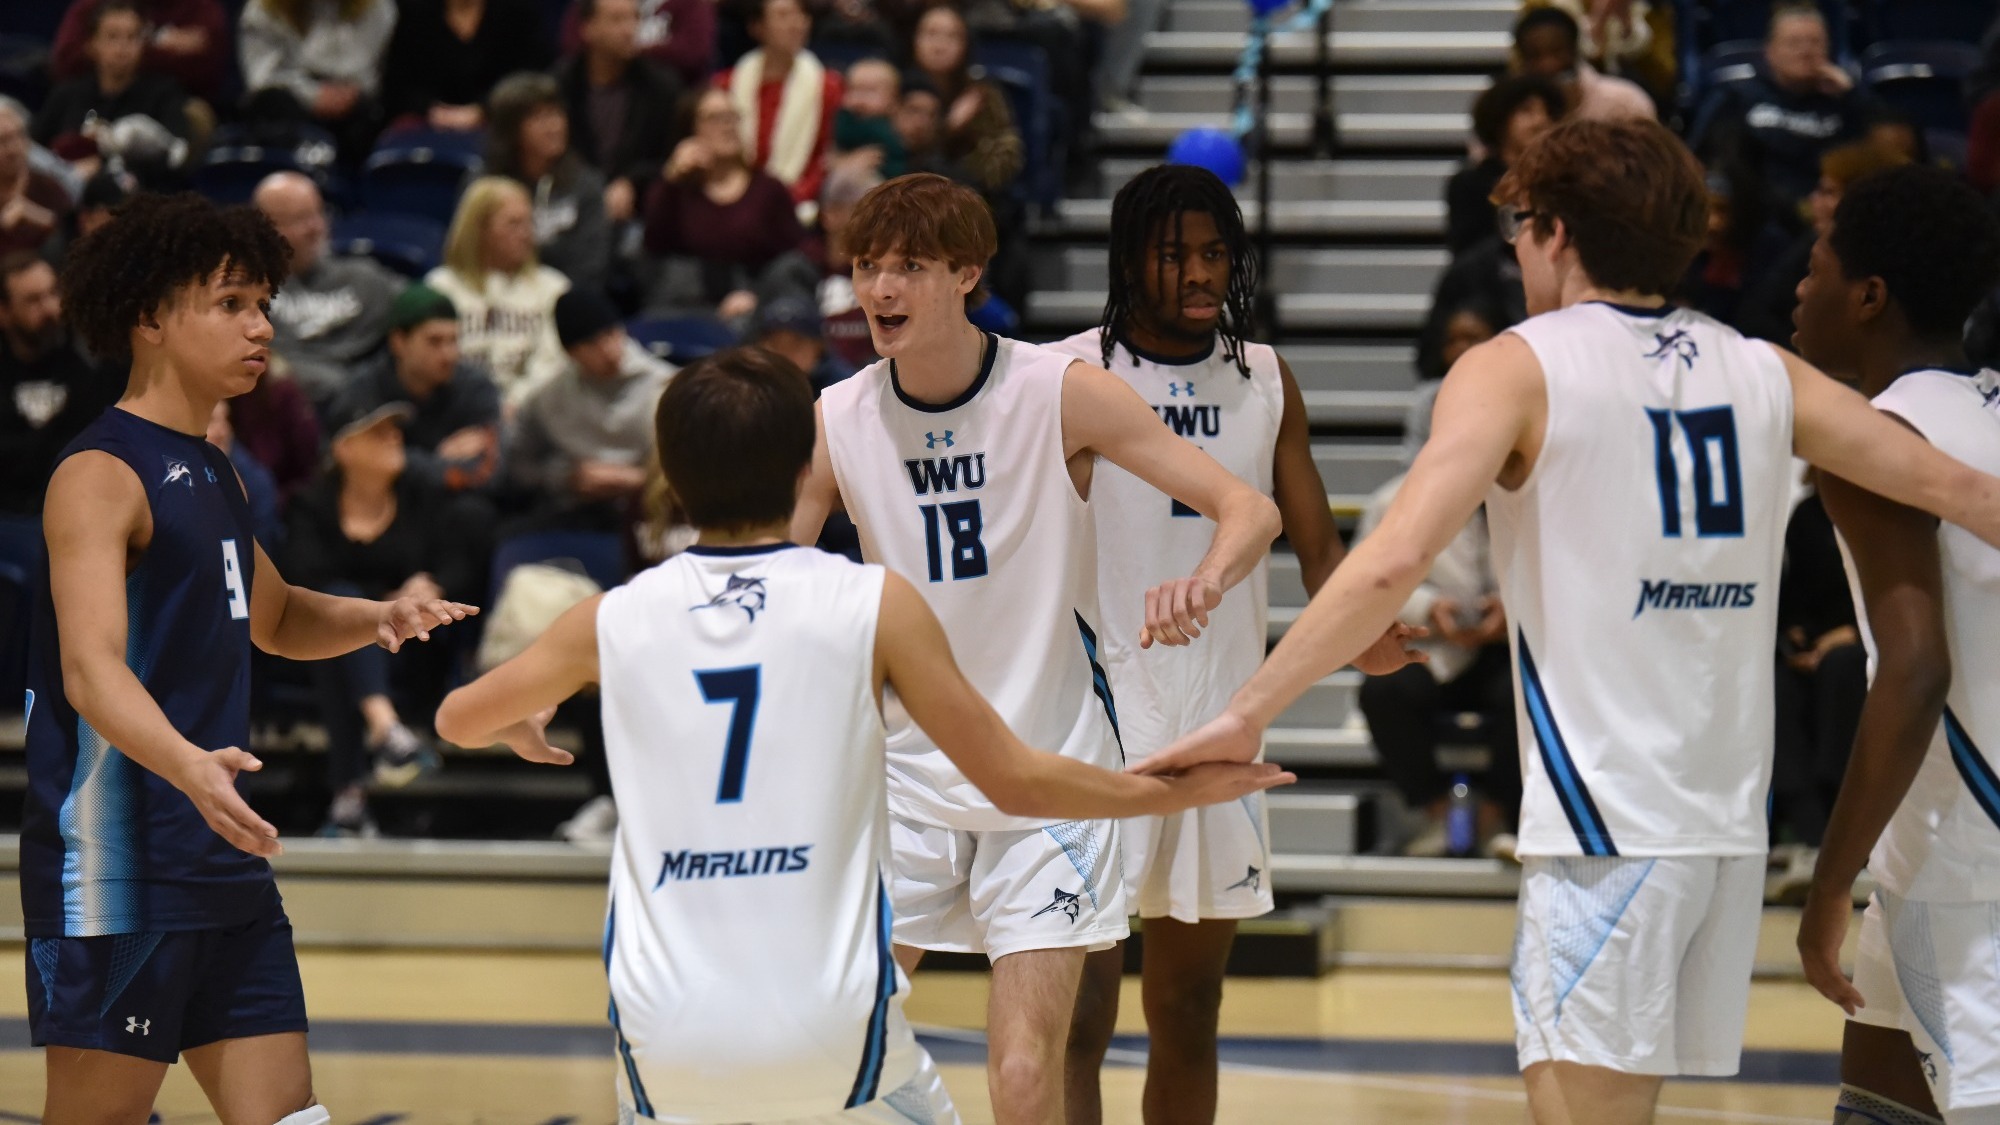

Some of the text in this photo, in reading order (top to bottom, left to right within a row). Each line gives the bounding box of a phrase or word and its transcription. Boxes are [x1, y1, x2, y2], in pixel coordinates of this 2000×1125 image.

[904, 452, 986, 496] VWU
[1644, 404, 1745, 538] 10
[221, 539, 249, 620] 9
[918, 499, 988, 582] 18
[1633, 579, 1757, 620] MARLINS
[692, 664, 761, 804] 7
[653, 845, 813, 892] MARLINS
